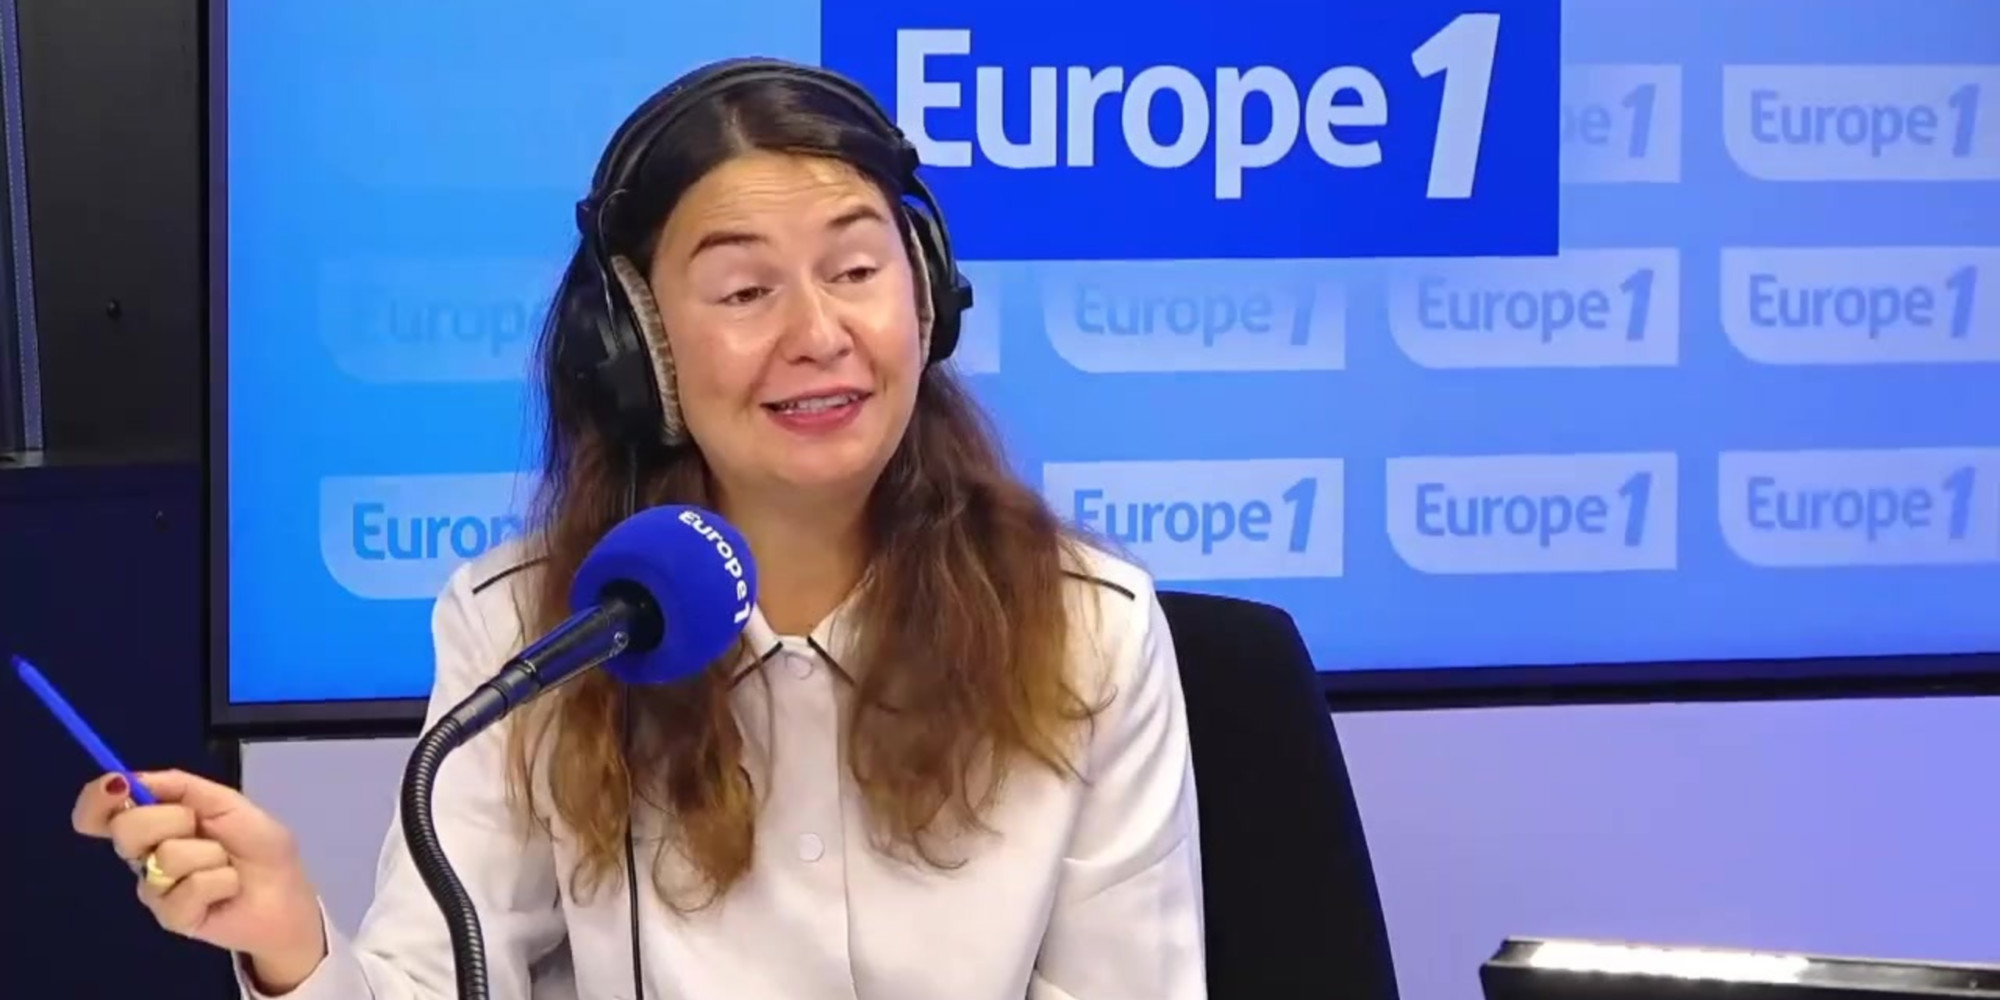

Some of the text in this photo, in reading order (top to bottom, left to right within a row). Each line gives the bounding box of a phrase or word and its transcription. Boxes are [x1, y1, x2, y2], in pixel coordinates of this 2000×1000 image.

[896, 12, 1501, 199] Europe 1
[1621, 82, 1657, 158] 1
[1750, 82, 1981, 158] Europe 1
[1075, 283, 1273, 347] Europe
[1418, 268, 1655, 344] Europe 1
[1749, 265, 1979, 340] Europe 1
[1073, 477, 1318, 555] Europe 1
[1416, 471, 1653, 548] Europe 1
[1747, 466, 1977, 542] Europe 1
[678, 510, 748, 601] Europe
